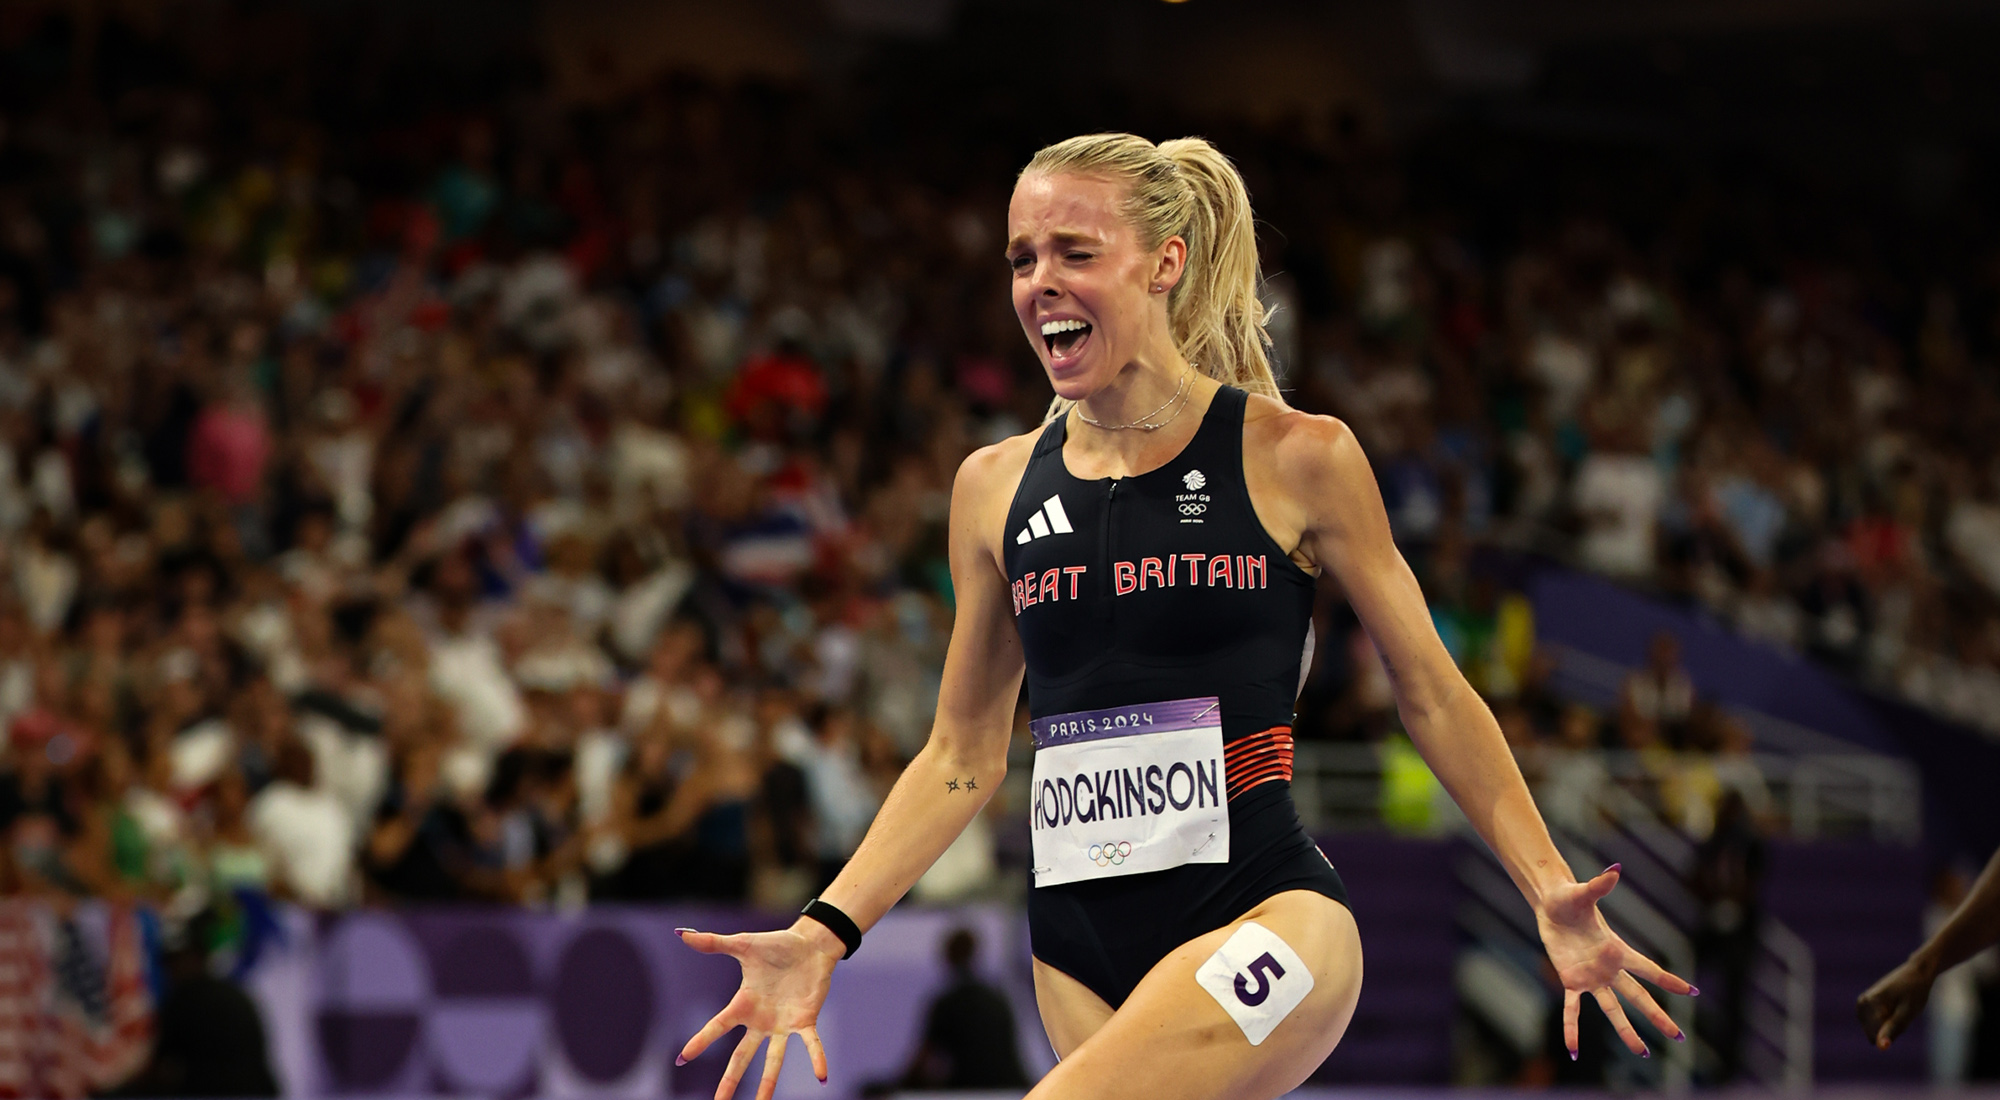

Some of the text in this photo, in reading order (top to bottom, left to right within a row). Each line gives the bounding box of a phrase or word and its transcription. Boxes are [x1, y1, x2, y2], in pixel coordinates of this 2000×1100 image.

[1175, 493, 1211, 502] TEAM GB
[1114, 553, 1267, 596] BRITAIN
[1102, 712, 1153, 731] 2024
[1034, 758, 1219, 831] HODGKINSON
[1233, 951, 1286, 1007] 5
